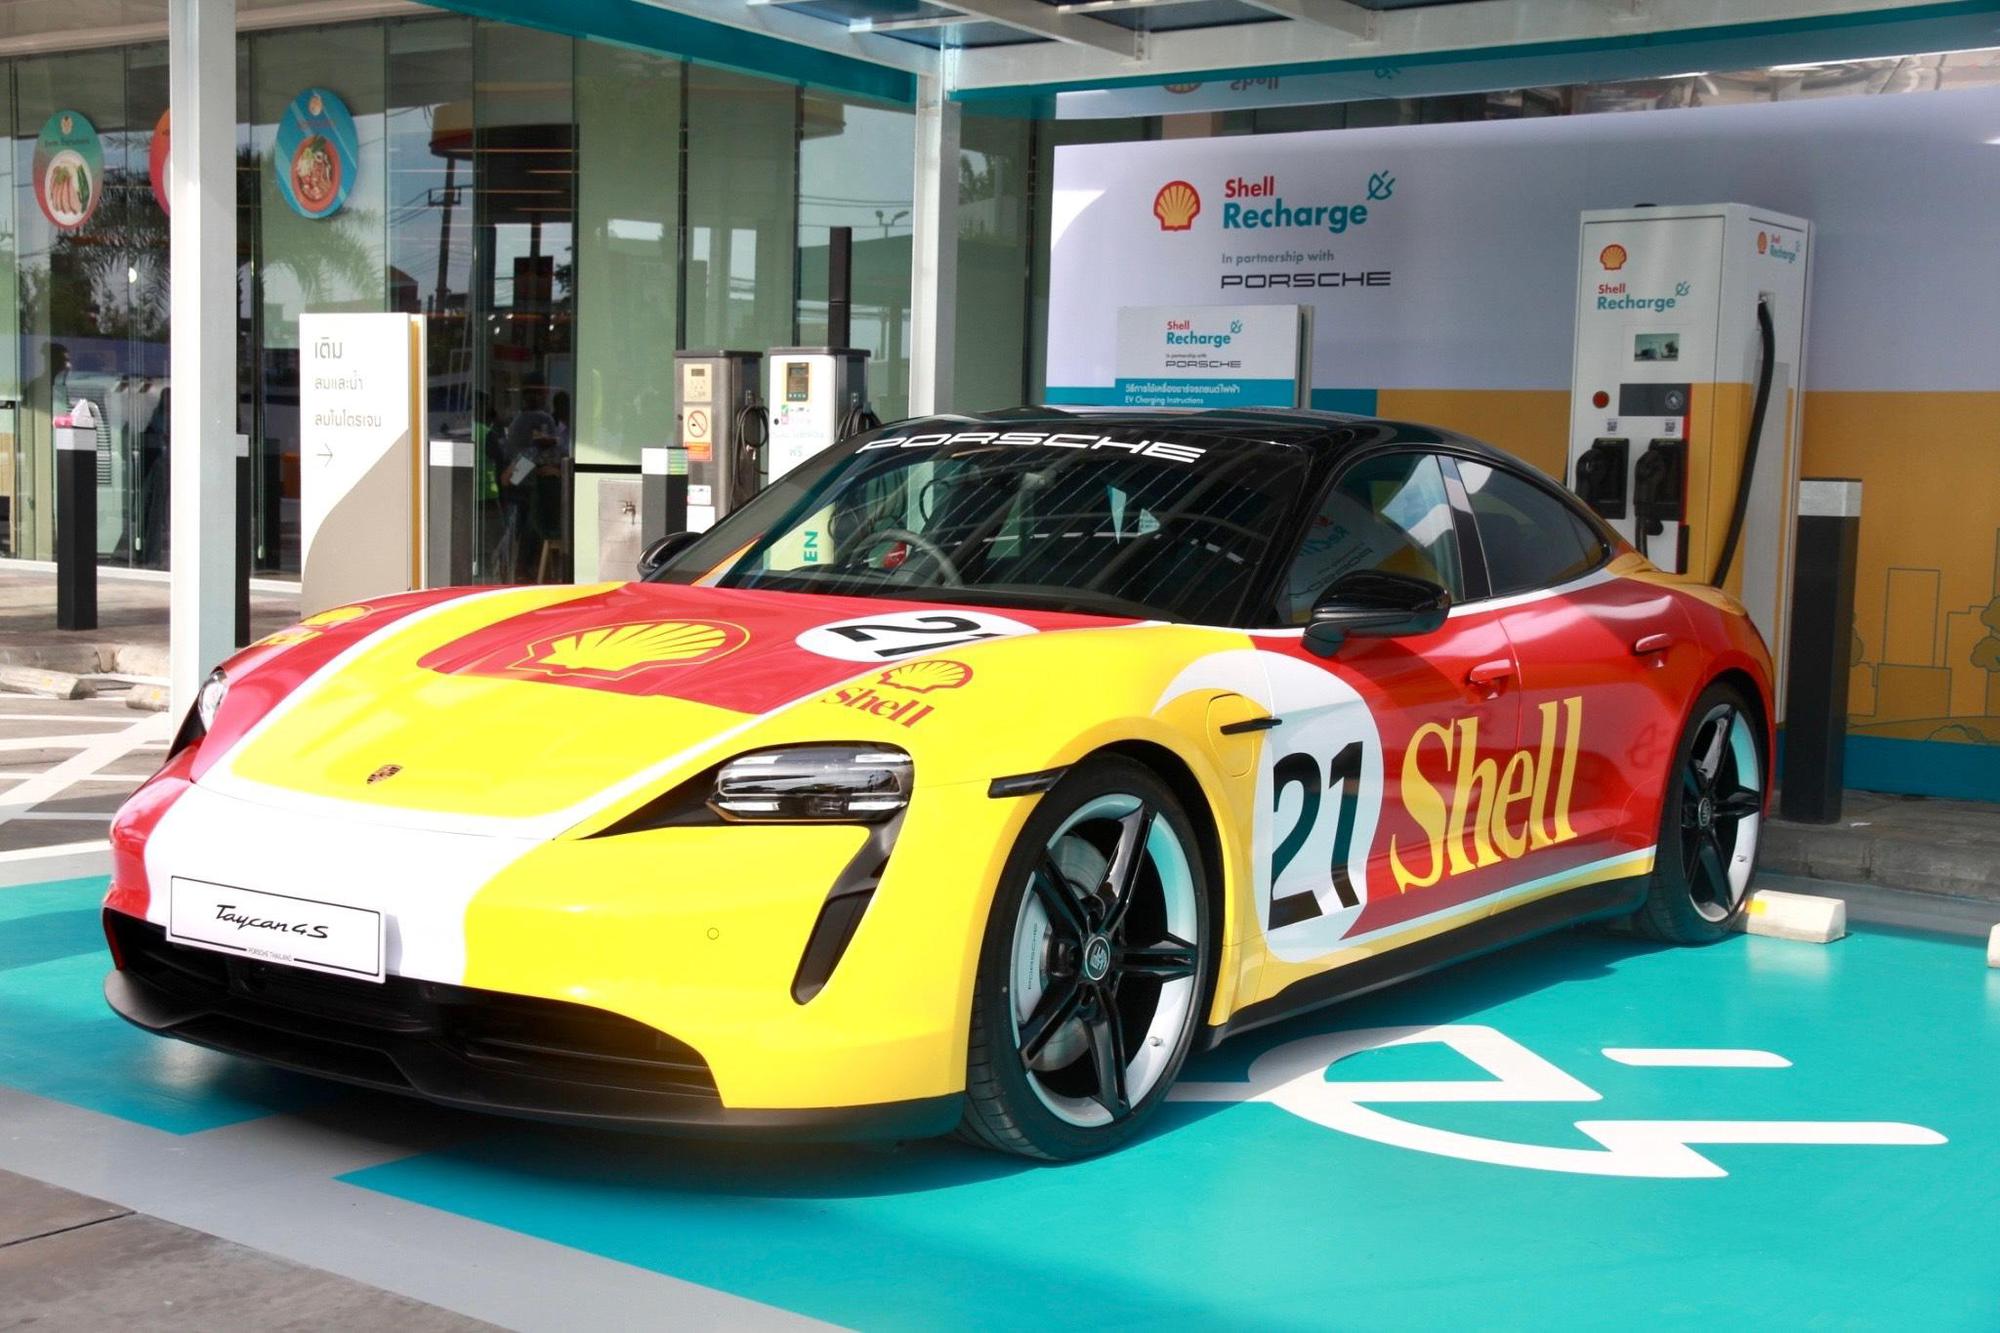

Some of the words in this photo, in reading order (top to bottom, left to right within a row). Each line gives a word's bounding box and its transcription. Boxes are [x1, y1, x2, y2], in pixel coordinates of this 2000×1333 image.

[1224, 176, 1274, 198] Shell
[1223, 198, 1368, 233] Recharge
[1222, 253, 1232, 264] In
[1235, 251, 1304, 266] partnership
[1307, 250, 1334, 262] with
[1221, 271, 1391, 289] PORSCHE
[1598, 283, 1626, 294] Shell
[1597, 295, 1676, 312] Recharge
[1167, 320, 1190, 330] Shell
[314, 336, 343, 359] เติม
[1166, 331, 1231, 348] Recharge
[1165, 360, 1242, 368] PORSCHE
[1125, 395, 1134, 403] EV
[1135, 395, 1165, 405] Charging
[1166, 396, 1204, 404] Instructions
[856, 432, 1206, 464] PORSCHE
[821, 687, 935, 729] Shell
[1390, 696, 1582, 894] Shell
[1268, 741, 1364, 931] 21
[216, 904, 288, 933] Taycan
